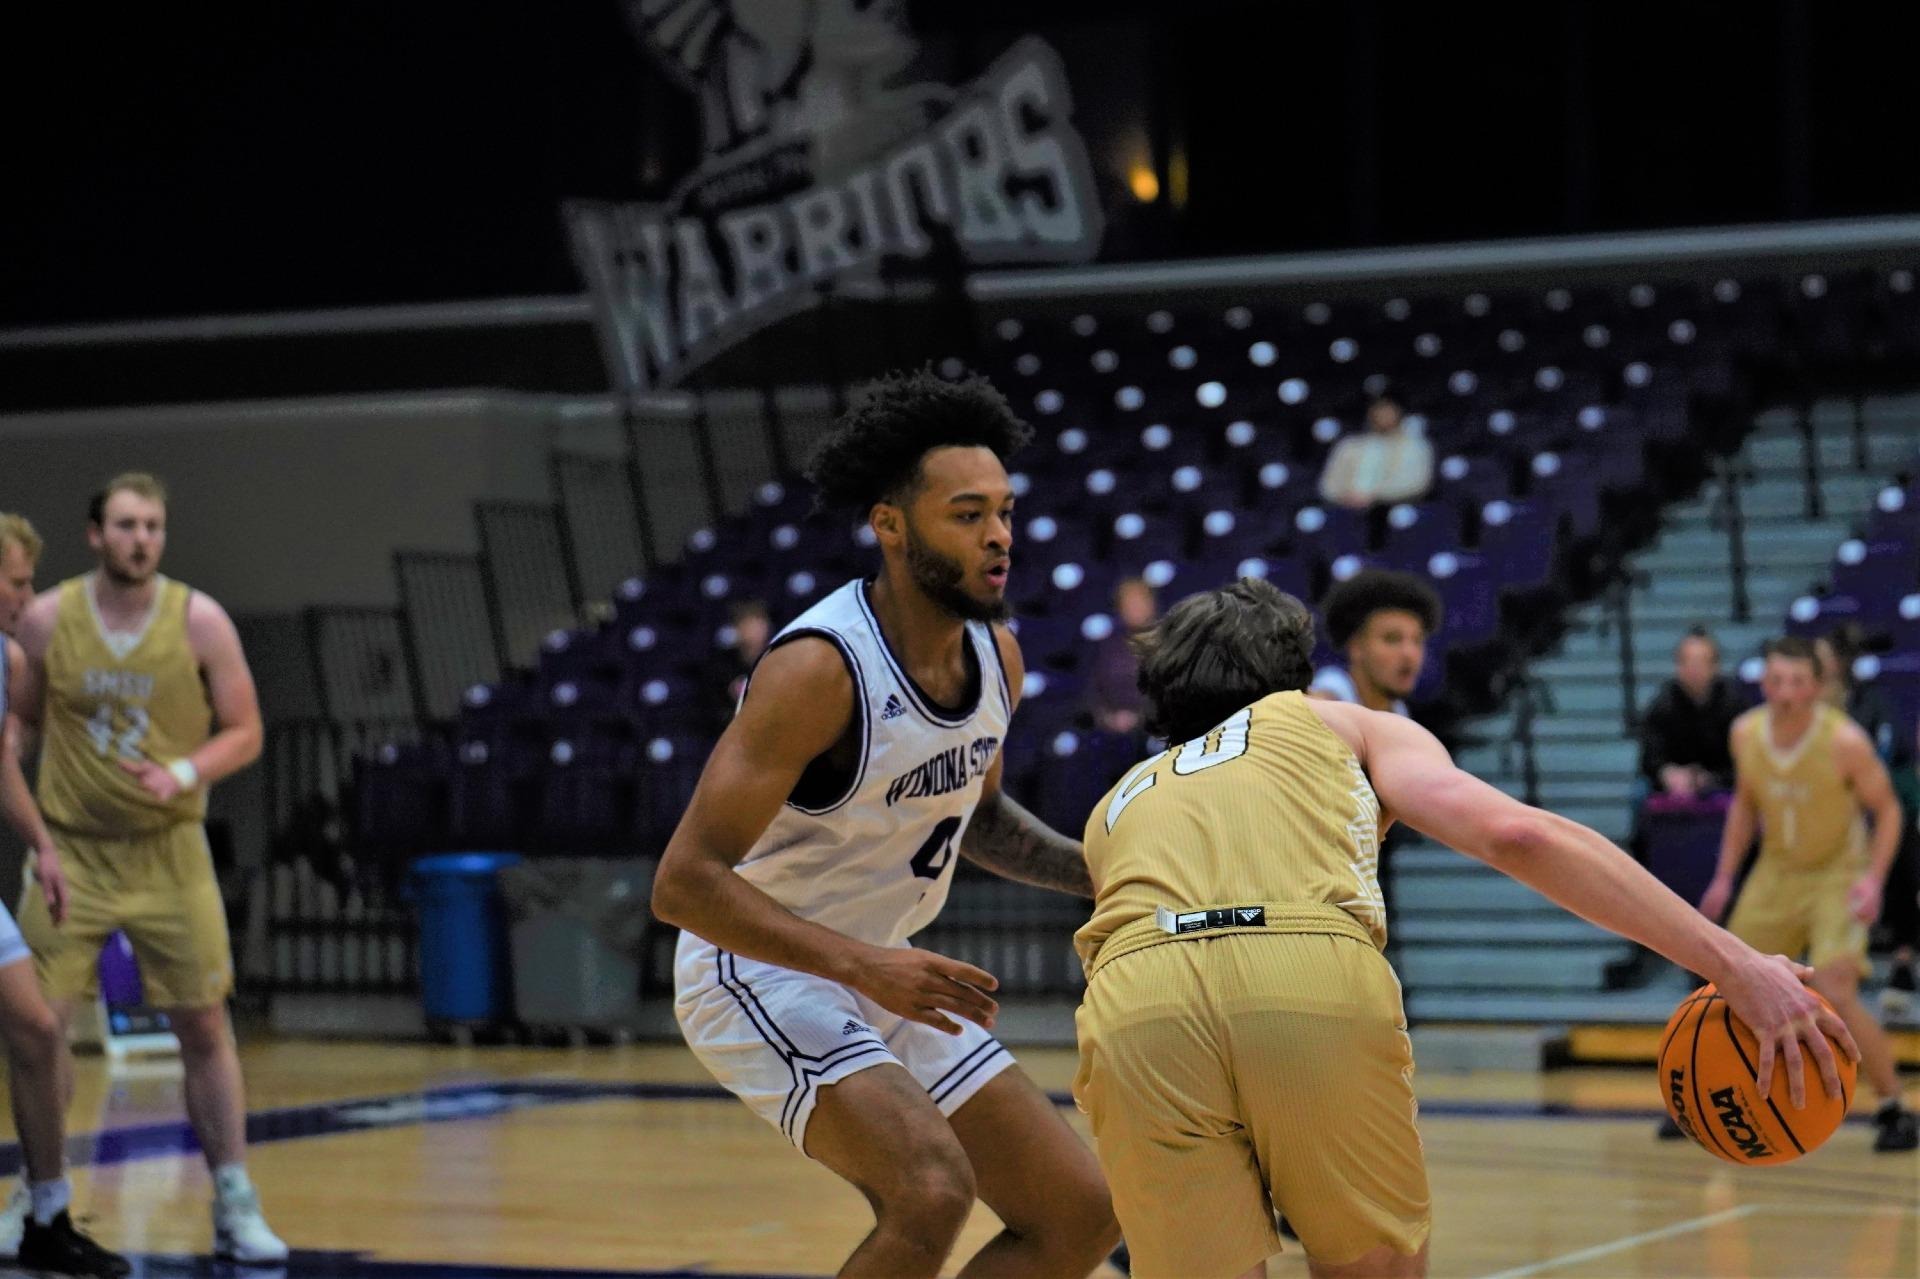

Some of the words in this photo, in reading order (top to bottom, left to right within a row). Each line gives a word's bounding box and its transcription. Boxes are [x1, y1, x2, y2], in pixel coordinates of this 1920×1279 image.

[86, 704, 150, 757] 42
[885, 745, 968, 807] WINONA
[910, 816, 963, 880] 0
[1710, 1087, 1774, 1158] NCAA
